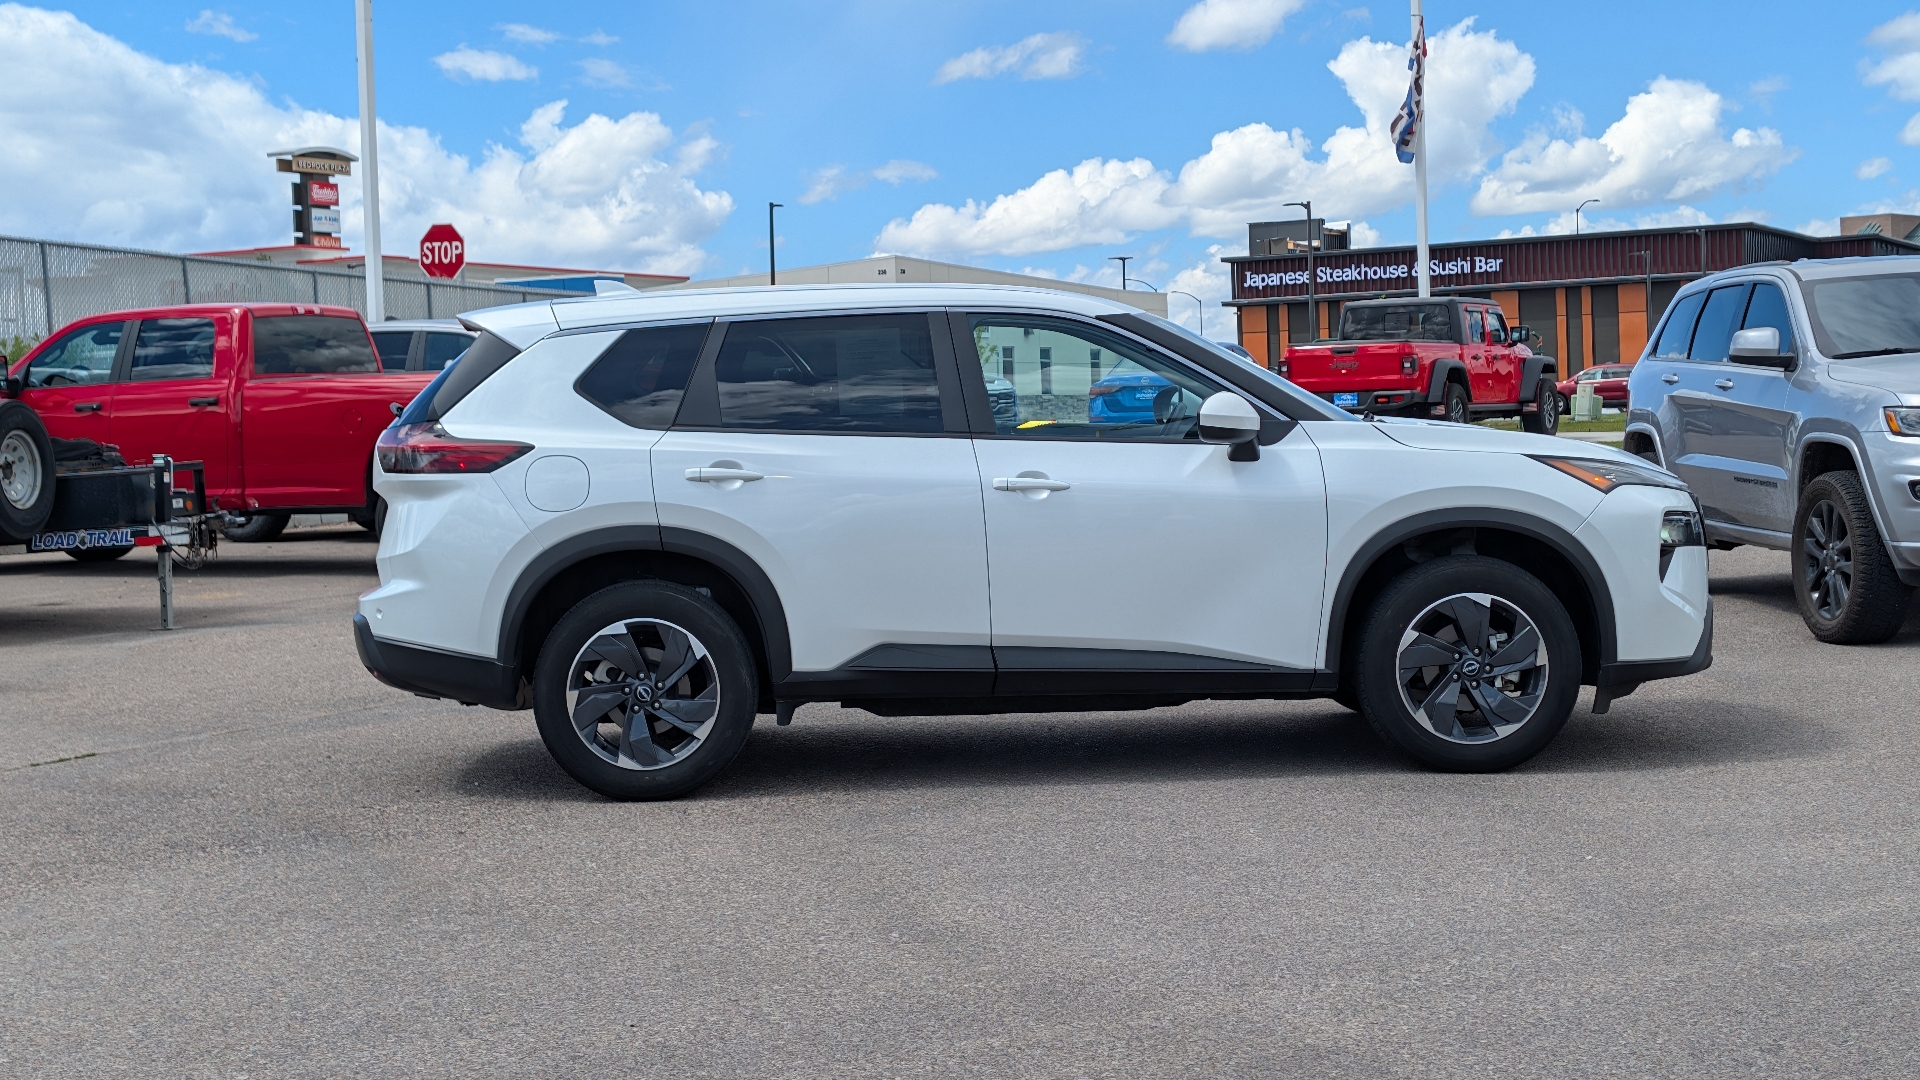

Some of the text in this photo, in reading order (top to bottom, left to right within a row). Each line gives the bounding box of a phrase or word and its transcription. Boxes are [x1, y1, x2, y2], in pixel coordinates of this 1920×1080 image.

[298, 160, 350, 173] BEDROCK PLAZA
[422, 241, 462, 264] STOP
[1243, 271, 1310, 289] Japanese
[1316, 263, 1408, 282] Steakhouse
[1429, 256, 1471, 276] Sushi
[1474, 256, 1503, 273] Bar
[1329, 358, 1360, 371] Jeep
[32, 529, 134, 550] LOAD TRAIL
